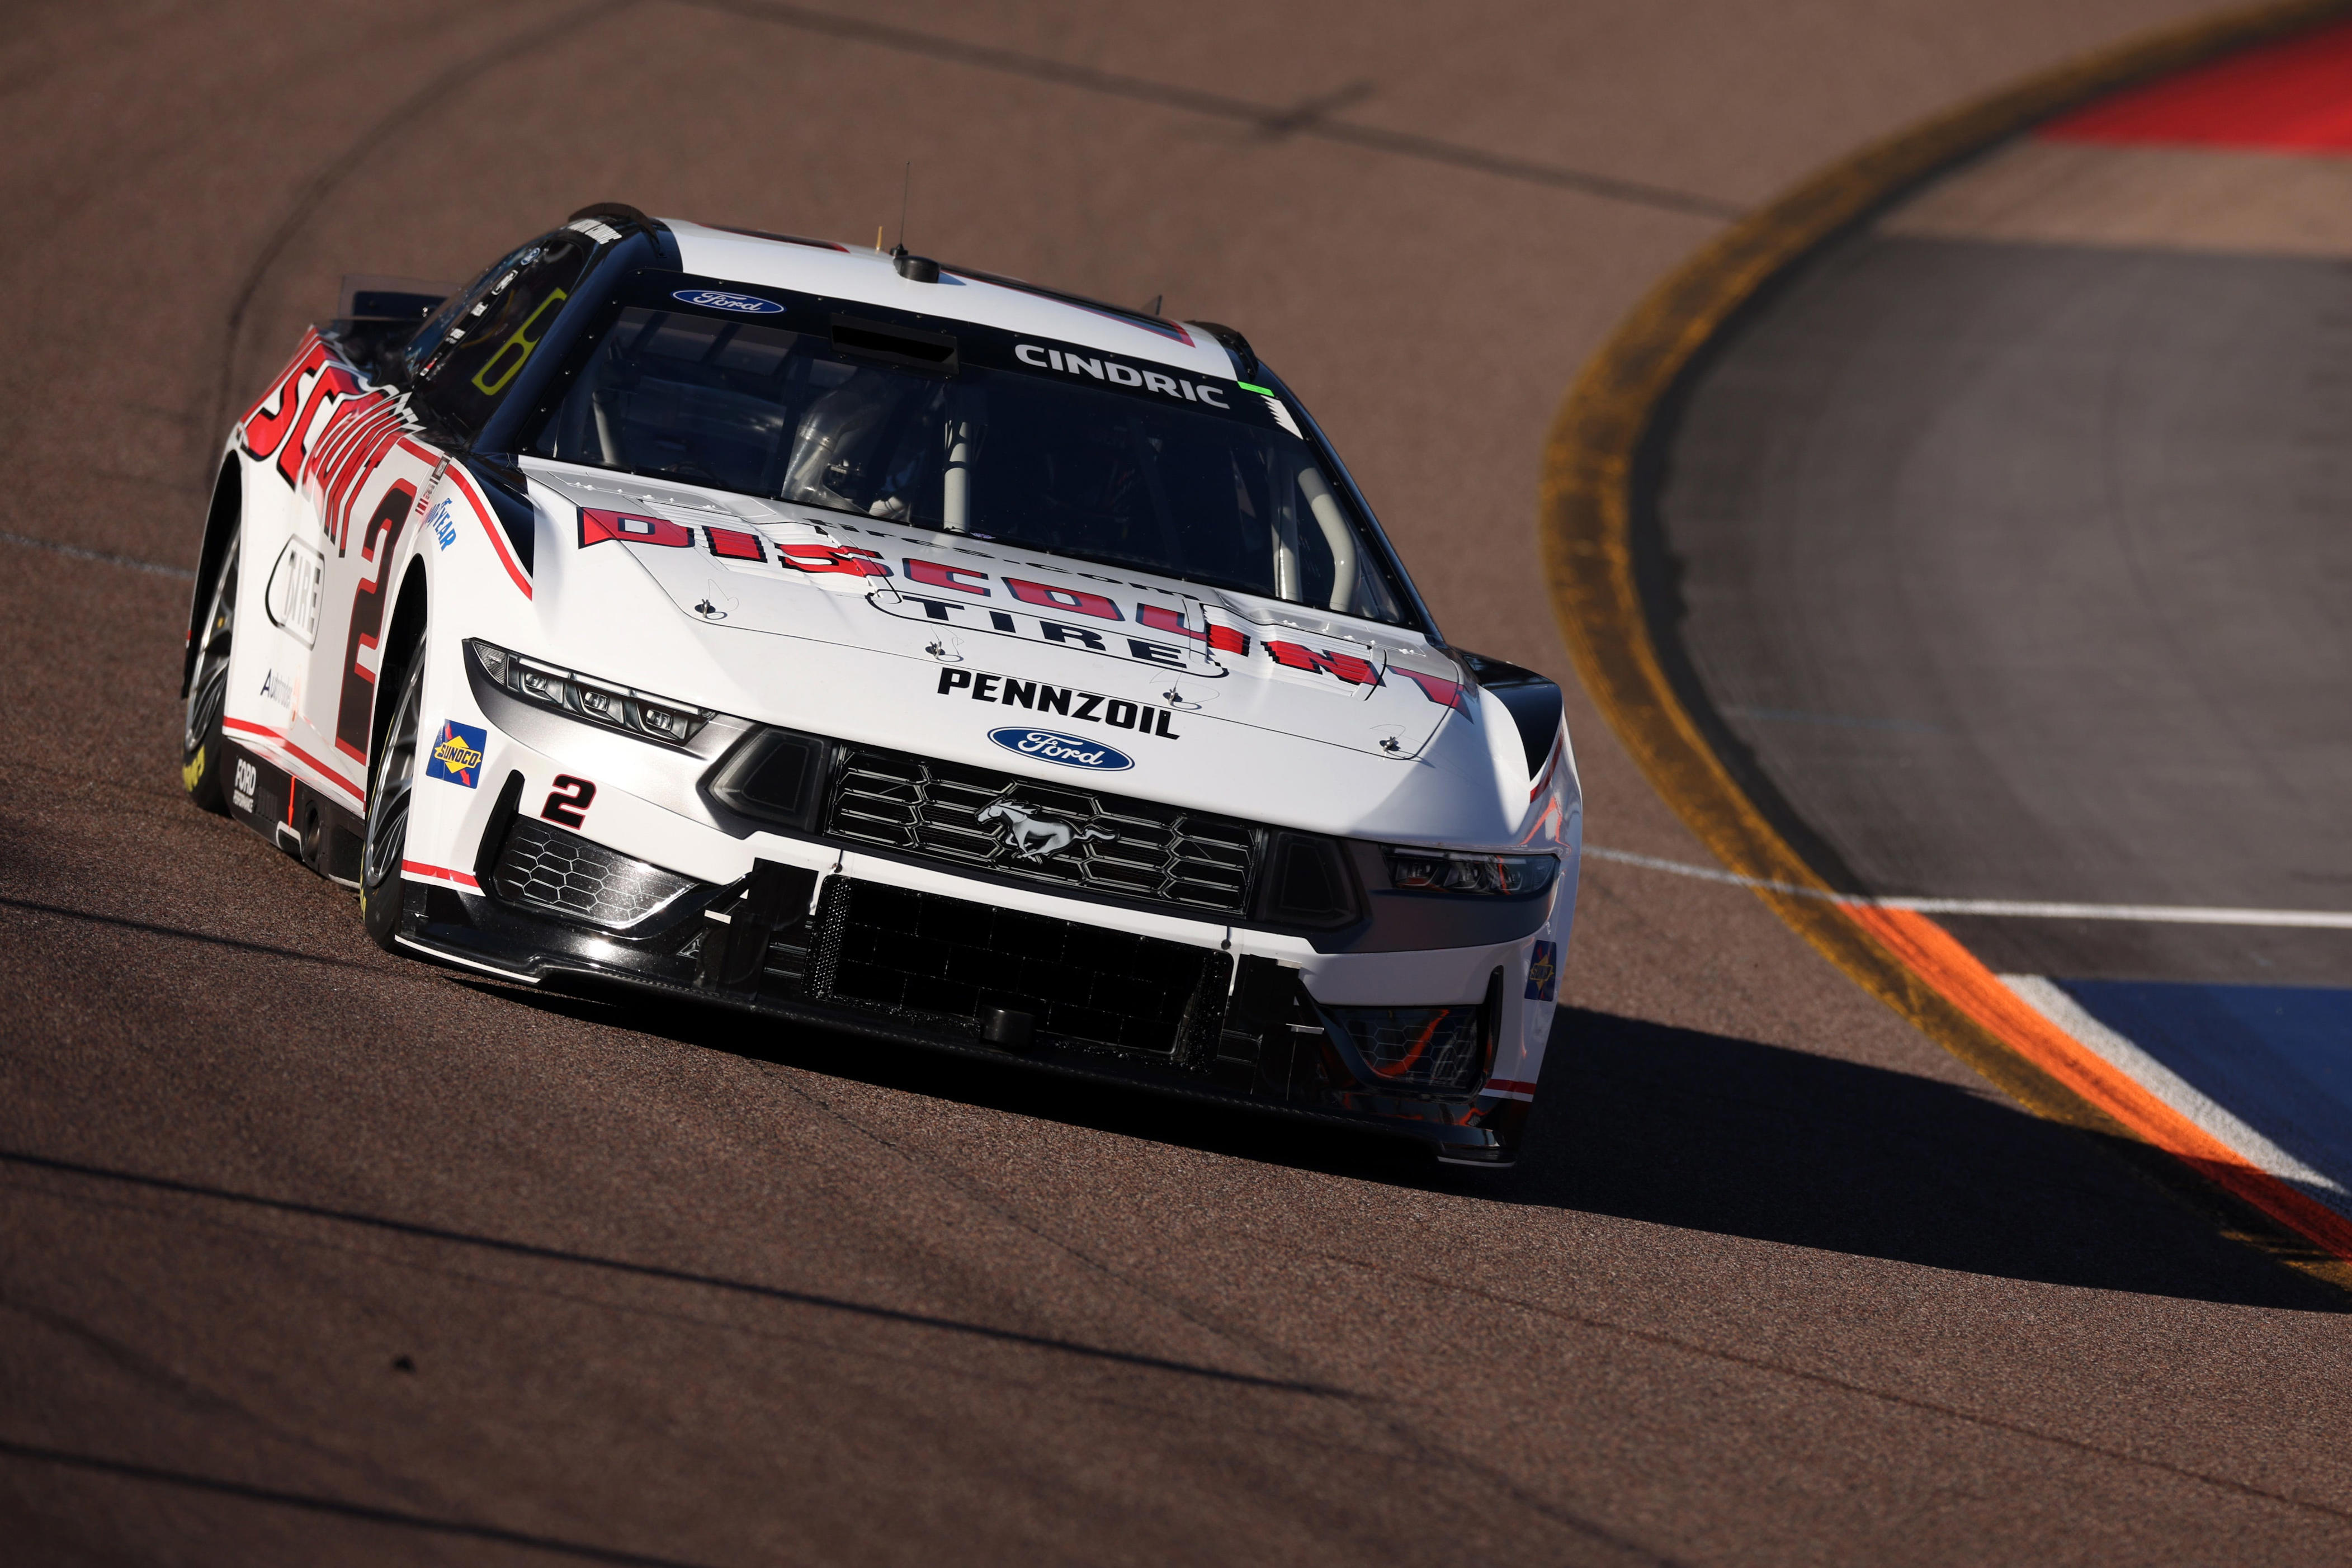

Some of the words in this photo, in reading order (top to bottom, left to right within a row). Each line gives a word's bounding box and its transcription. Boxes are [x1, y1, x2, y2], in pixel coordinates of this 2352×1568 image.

[693, 291, 763, 311] Ford
[1014, 344, 1230, 409] CINDRIC
[803, 518, 1201, 601] tires.com
[334, 478, 418, 766] 2
[577, 507, 1475, 725] DISCOUNT
[902, 595, 1188, 669] TIRE
[937, 667, 1180, 740] PENNZOIL
[235, 758, 257, 796] FORD
[437, 744, 479, 767] SUNOCO
[1017, 731, 1105, 766] Ford
[540, 773, 597, 830] 2
